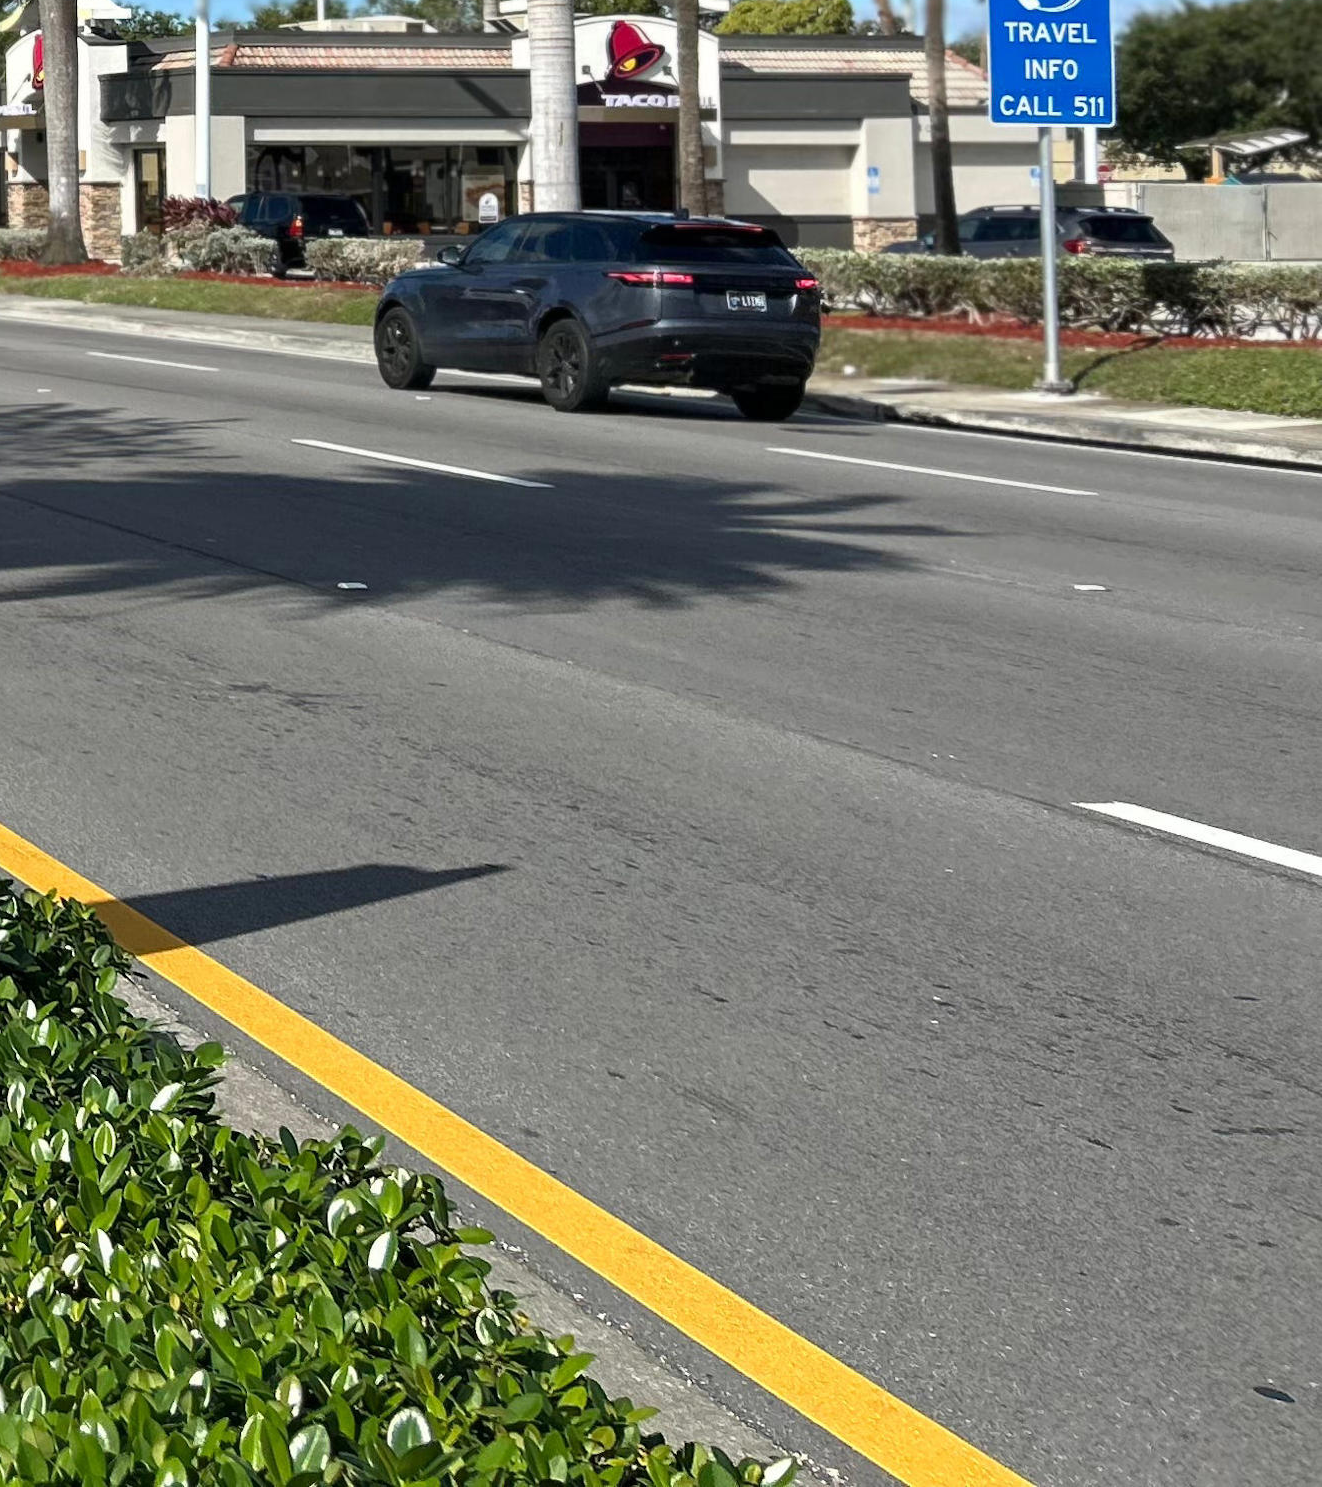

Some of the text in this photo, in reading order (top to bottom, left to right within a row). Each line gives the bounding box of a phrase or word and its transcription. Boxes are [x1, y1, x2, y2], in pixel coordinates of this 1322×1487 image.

[1004, 21, 1097, 44] TRAVEL
[1024, 59, 1079, 81] INFO
[601, 94, 666, 108] TACO
[999, 95, 1105, 117] CALL 511
